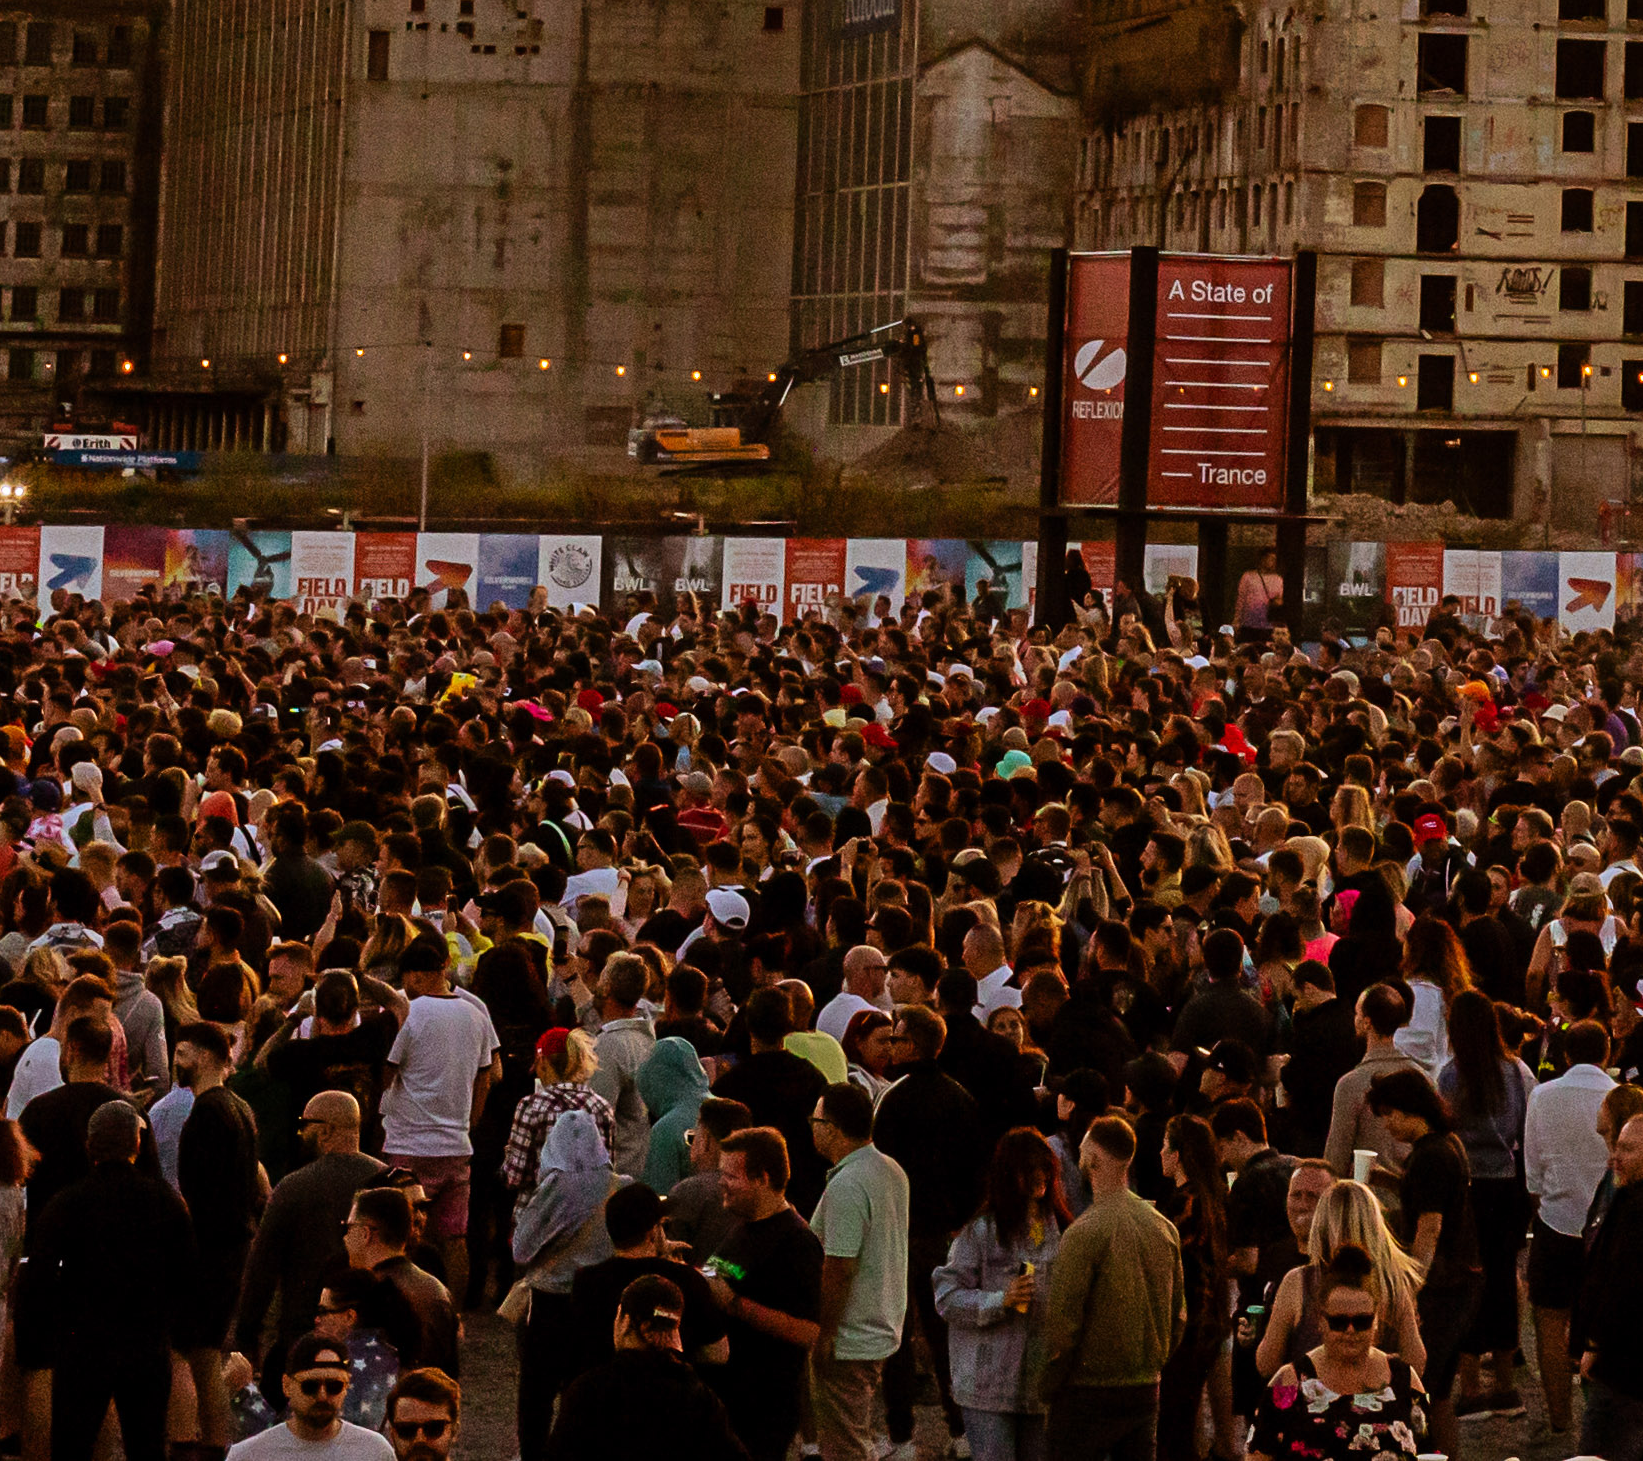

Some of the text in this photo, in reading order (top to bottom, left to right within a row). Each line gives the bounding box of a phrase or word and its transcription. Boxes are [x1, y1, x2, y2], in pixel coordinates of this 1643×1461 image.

[1168, 280, 1273, 304] A State of
[82, 438, 111, 449] Erith
[1198, 462, 1267, 485] Trance
[297, 578, 346, 597] FIELD
[729, 583, 777, 603] FIELD
[1339, 583, 1375, 597] BWL
[1392, 586, 1439, 606] FIELD
[1398, 607, 1432, 627] DAY
